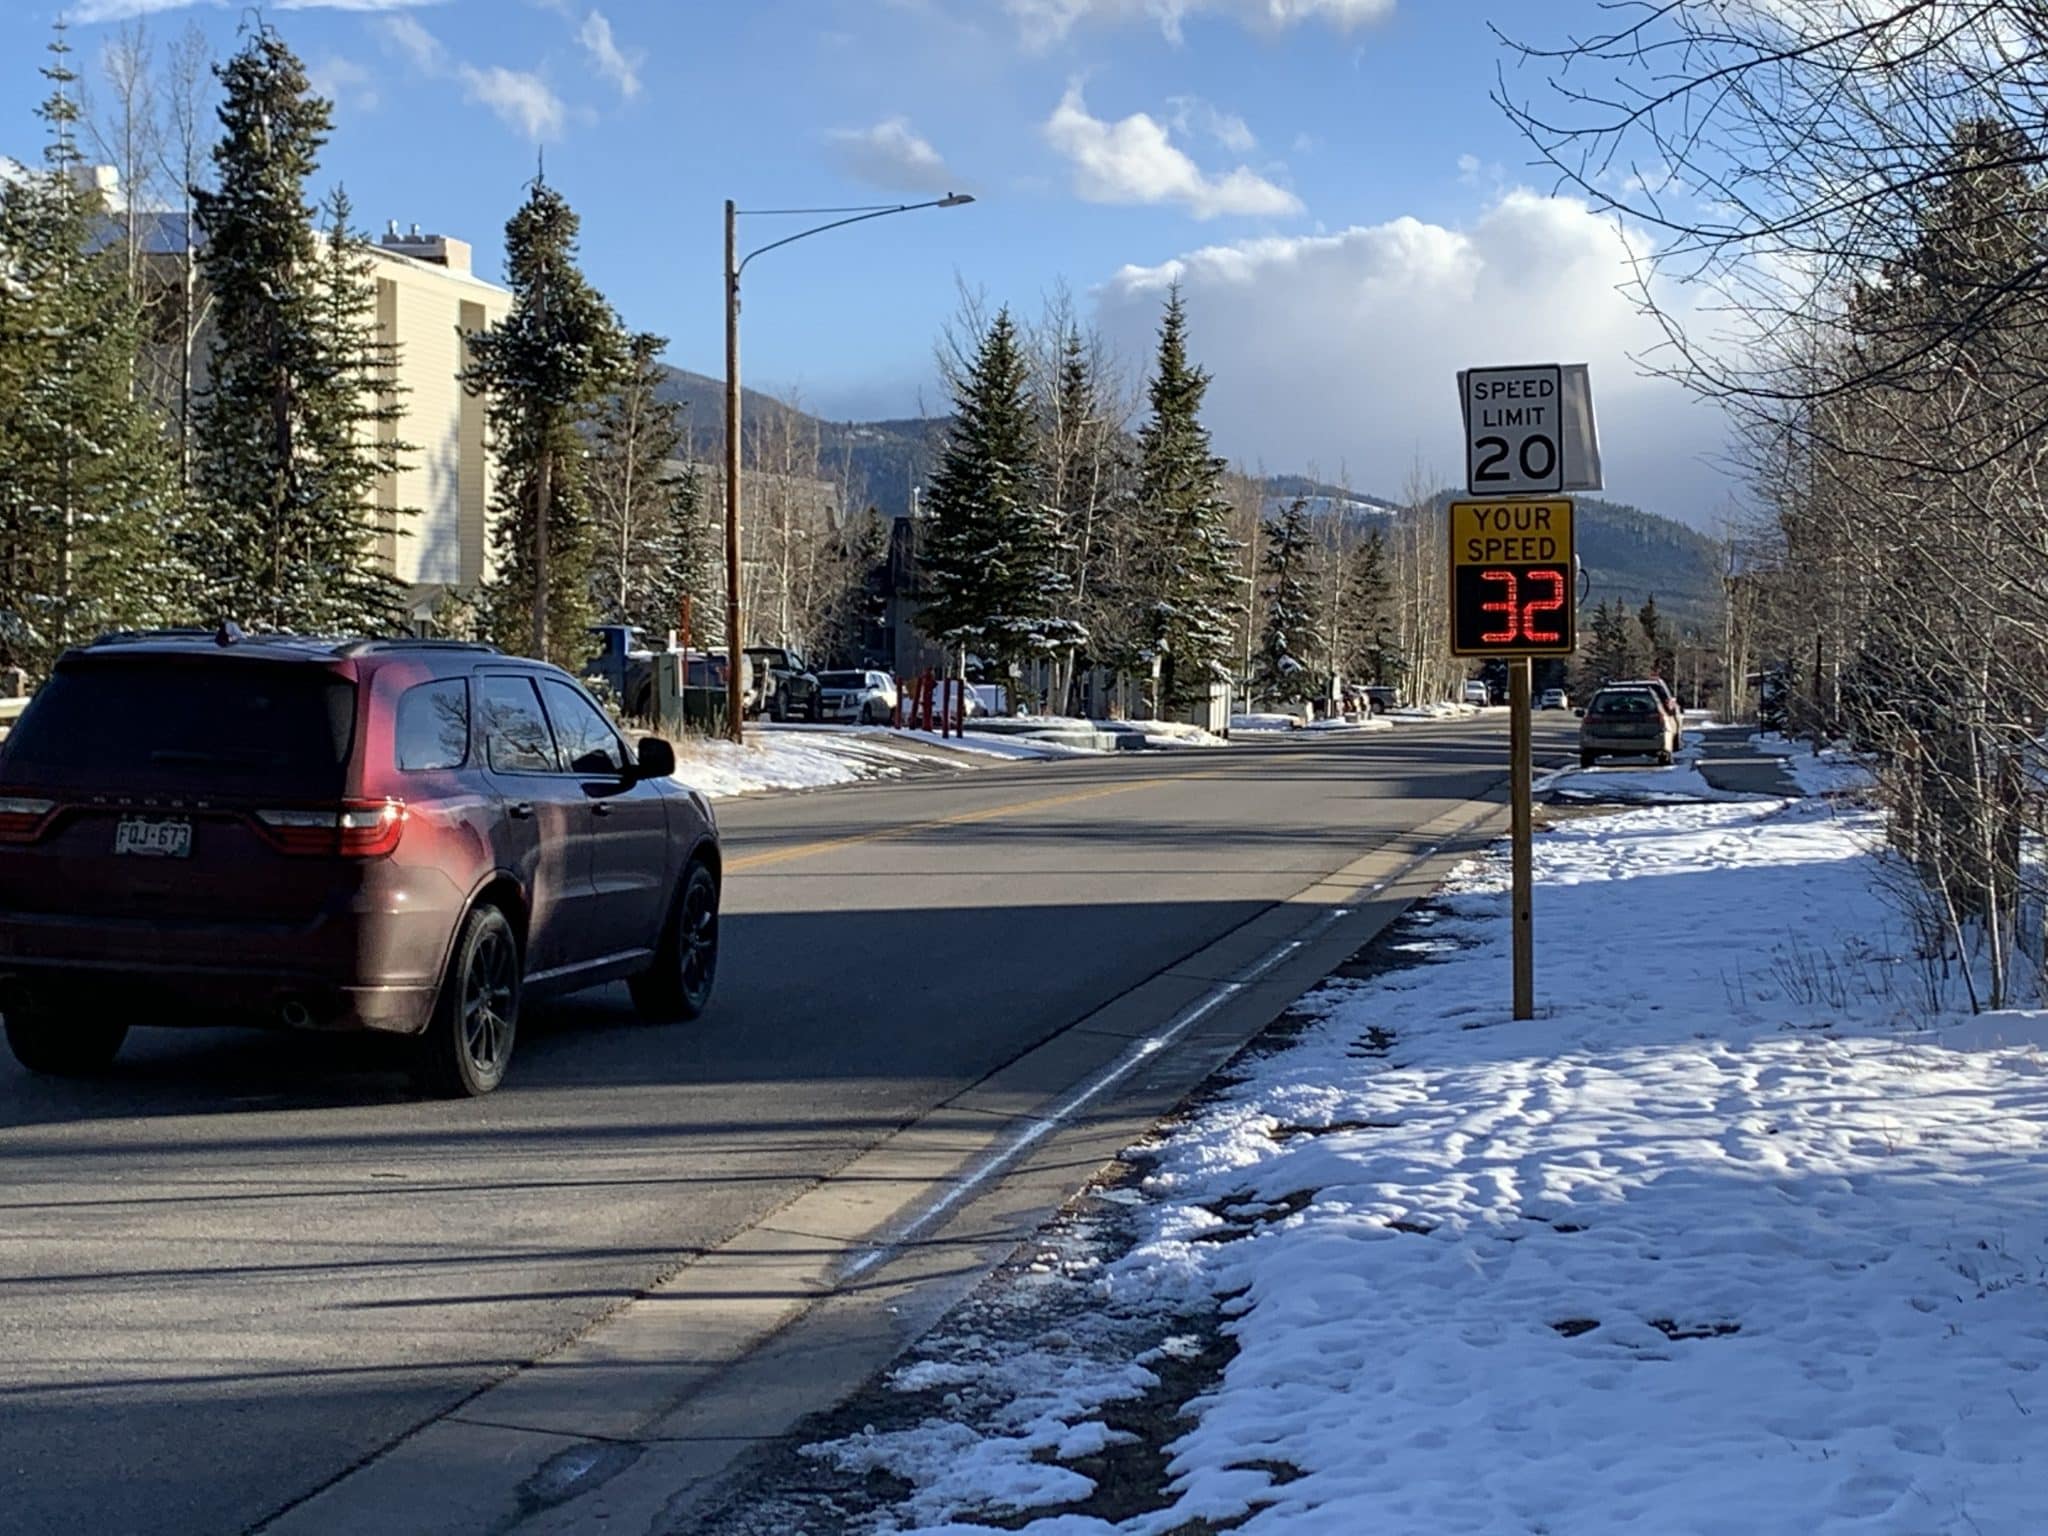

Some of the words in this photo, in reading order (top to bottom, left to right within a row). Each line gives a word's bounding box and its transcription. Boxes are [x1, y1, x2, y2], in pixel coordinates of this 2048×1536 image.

[1474, 379, 1554, 400] SPEED
[1483, 407, 1545, 427] LIMIT
[1474, 434, 1556, 481] 20
[1473, 507, 1551, 531] YOUR
[1467, 537, 1556, 561] SPEED
[1481, 571, 1563, 642] 32
